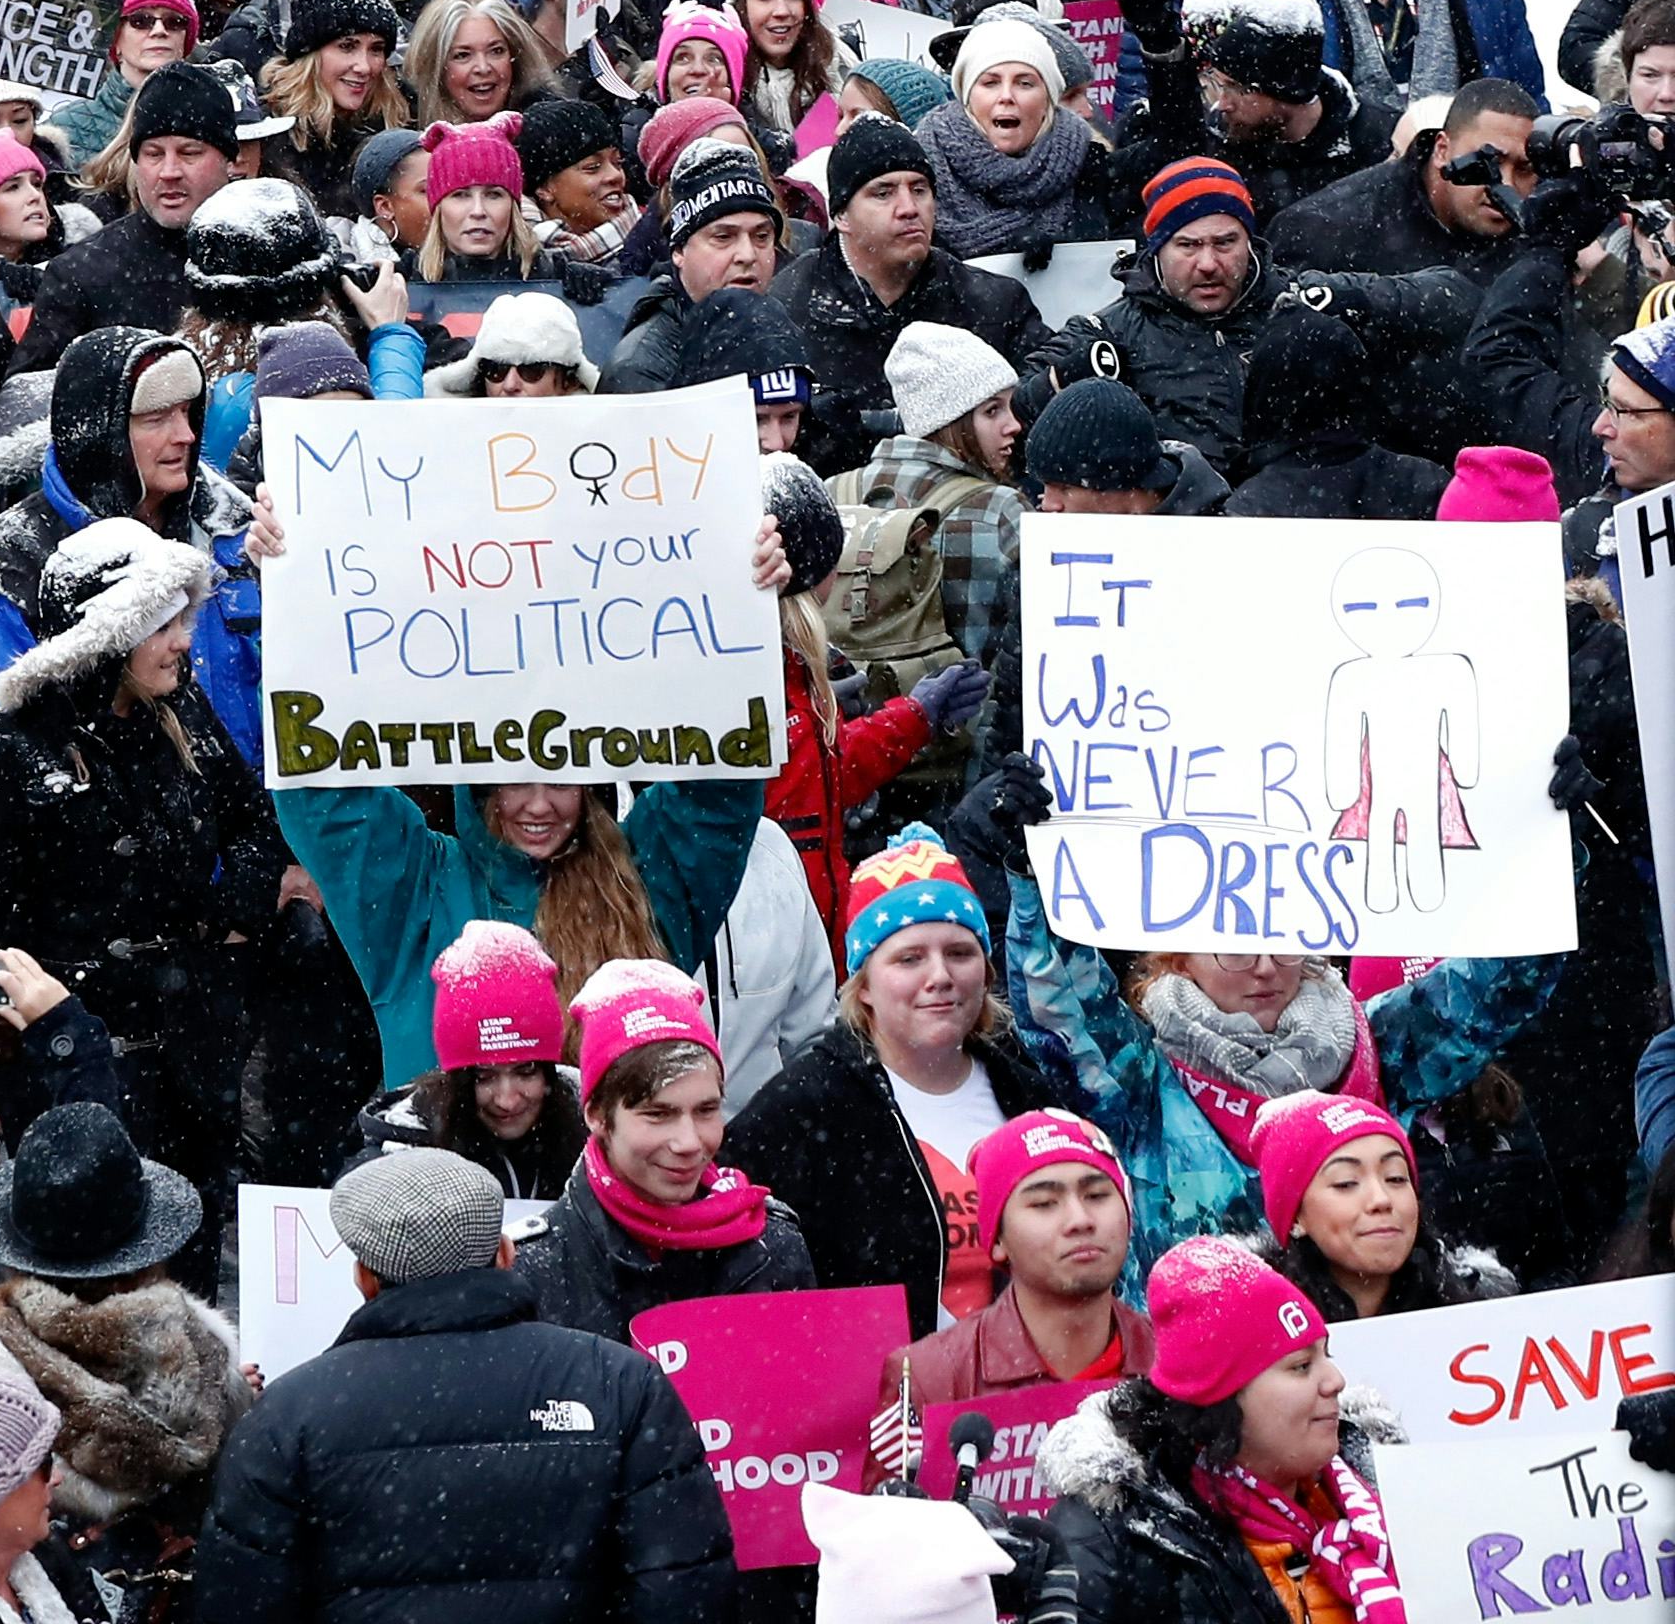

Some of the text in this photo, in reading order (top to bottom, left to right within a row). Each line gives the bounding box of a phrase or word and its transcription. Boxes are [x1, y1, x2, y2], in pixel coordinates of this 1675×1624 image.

[69, 10, 94, 48] &
[325, 545, 376, 596] IS
[423, 541, 551, 592] NOT
[346, 595, 763, 676] POLITICAL
[1033, 738, 1311, 829] NEVER
[1053, 823, 1359, 949] A DRESS
[547, 1400, 571, 1412] THE
[1450, 1324, 1675, 1427] SAVE
[530, 1410, 571, 1422] NORTH
[543, 1420, 572, 1432] FACE
[1530, 1447, 1648, 1521] The
